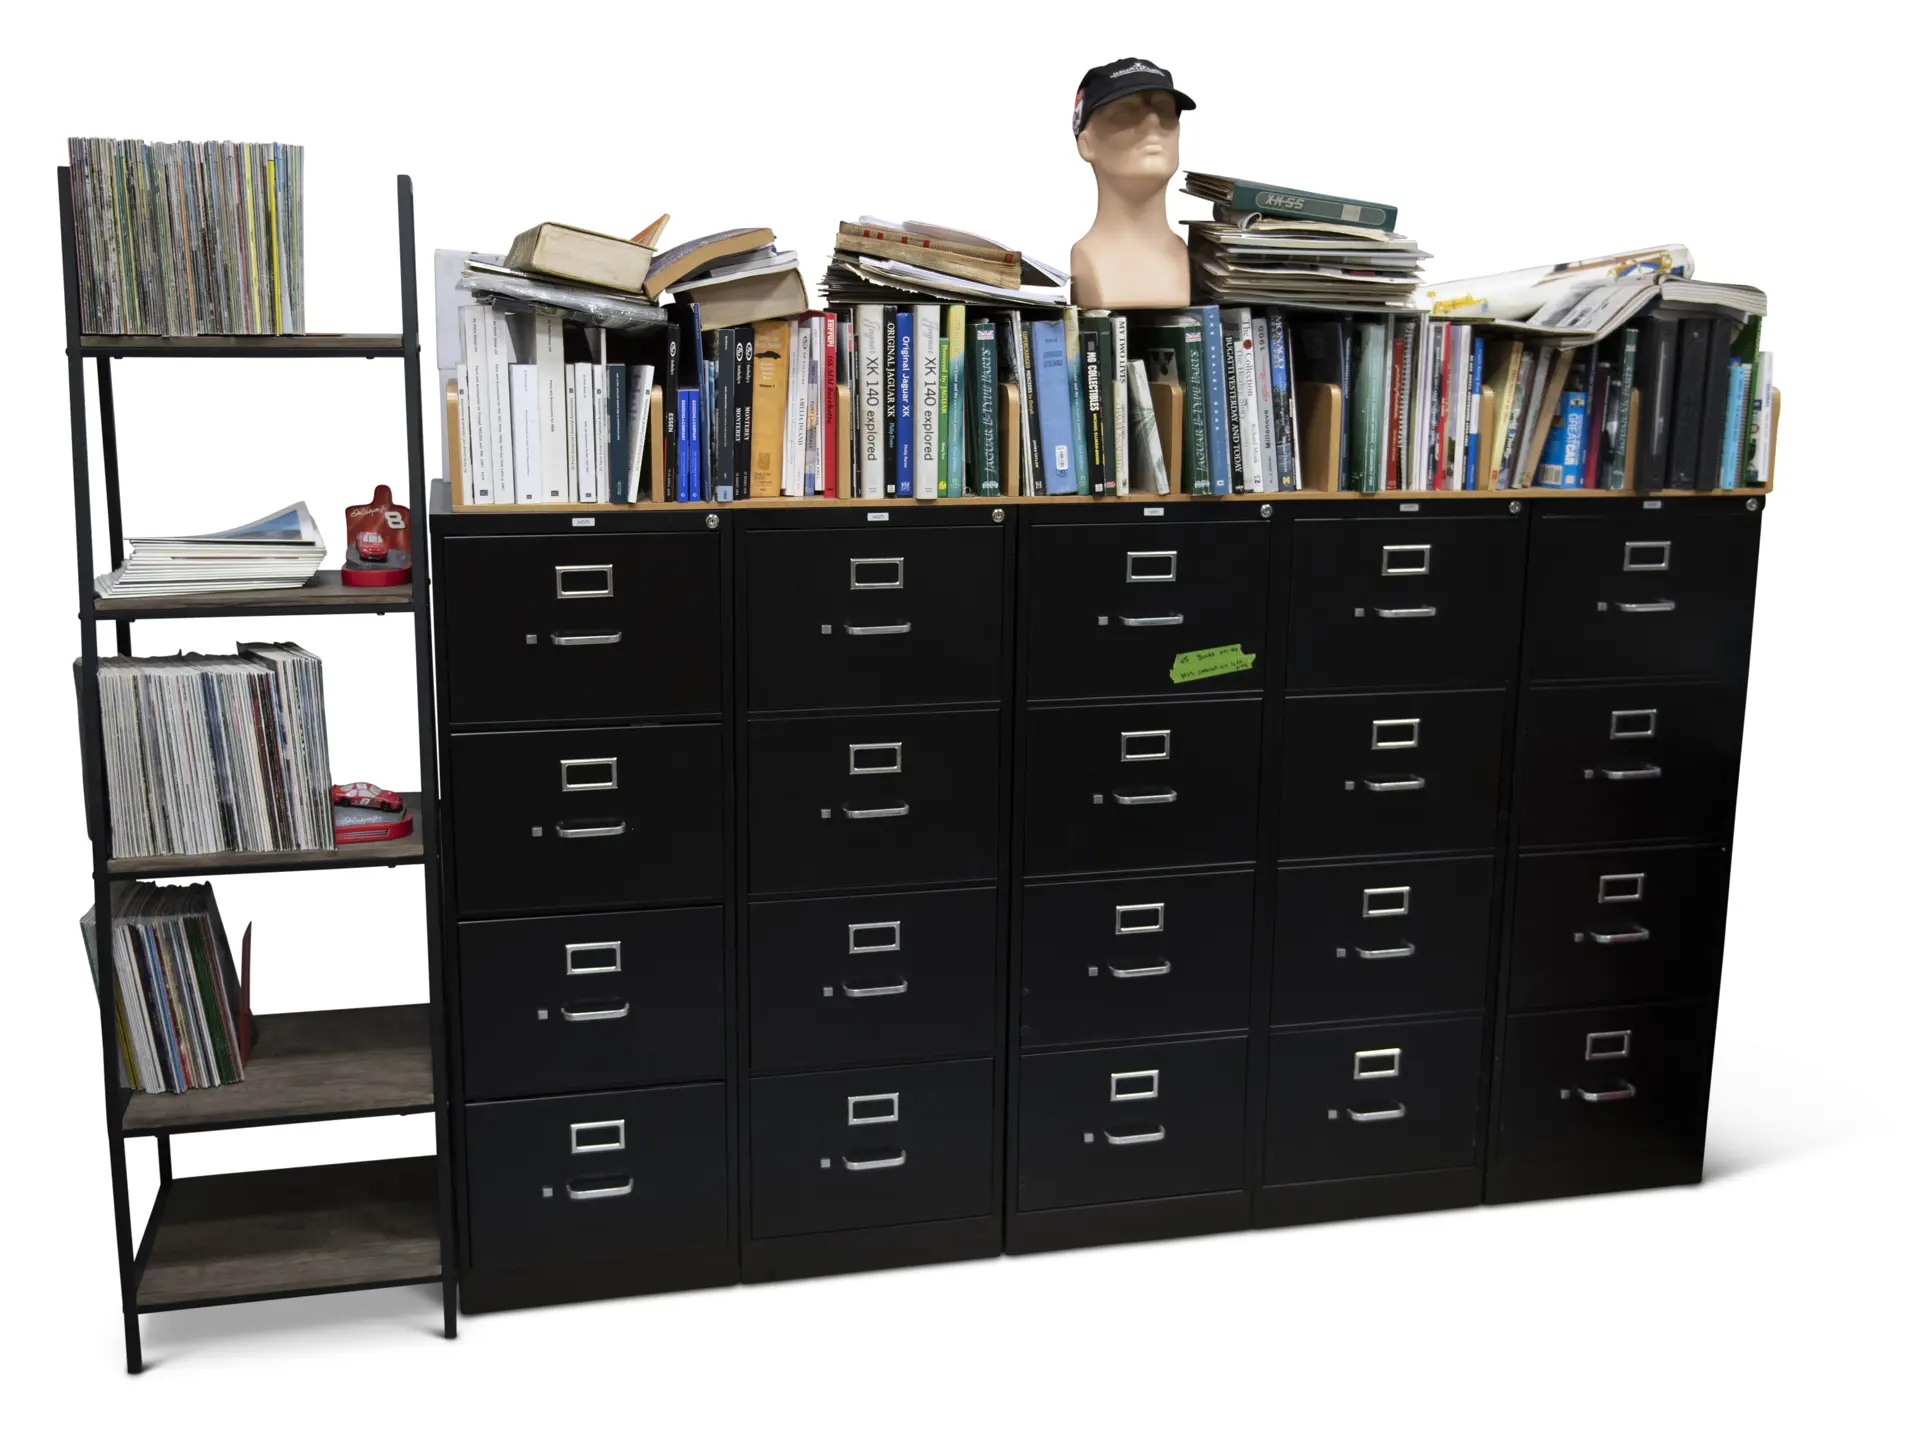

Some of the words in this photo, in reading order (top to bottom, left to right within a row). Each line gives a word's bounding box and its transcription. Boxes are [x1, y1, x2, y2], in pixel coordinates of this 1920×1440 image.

[1119, 321, 1126, 337] MY
[1243, 320, 1251, 337] The
[1276, 315, 1285, 369] MONACO
[887, 322, 895, 367] ORIGINAL
[901, 336, 910, 371] Original
[1022, 330, 1031, 369] SUPERCHARGED
[1087, 351, 1096, 363] MG
[1225, 336, 1235, 375] BUGATTI
[867, 356, 879, 376] XK
[924, 356, 937, 376] XK
[940, 375, 947, 384] by
[981, 347, 993, 383] PARTS
[1190, 349, 1202, 384] PARTS
[1245, 352, 1254, 397] Collection
[866, 380, 880, 407] 140
[886, 367, 895, 403] JAGUAR
[901, 373, 910, 403] Jaguar
[924, 380, 937, 407] 140
[1025, 369, 1033, 394] MERCEDES
[1088, 364, 1100, 412] COLLECTIBLES
[1237, 366, 1246, 395] Healey
[887, 404, 895, 417] XK
[902, 405, 910, 417] XK
[940, 385, 948, 414] JAGUAR
[1192, 386, 1205, 426] E-TYPE
[1228, 375, 1238, 422] YESTERDAY
[1238, 397, 1248, 420] Story
[865, 410, 879, 461] explored
[923, 410, 934, 461] explored
[1232, 424, 1240, 443] AND
[1264, 409, 1272, 449] Millenove
[984, 428, 997, 474] JAGUAR
[1195, 428, 1208, 472] JAGUAR
[1233, 444, 1242, 473] TODAY
[384, 511, 406, 529] 8
